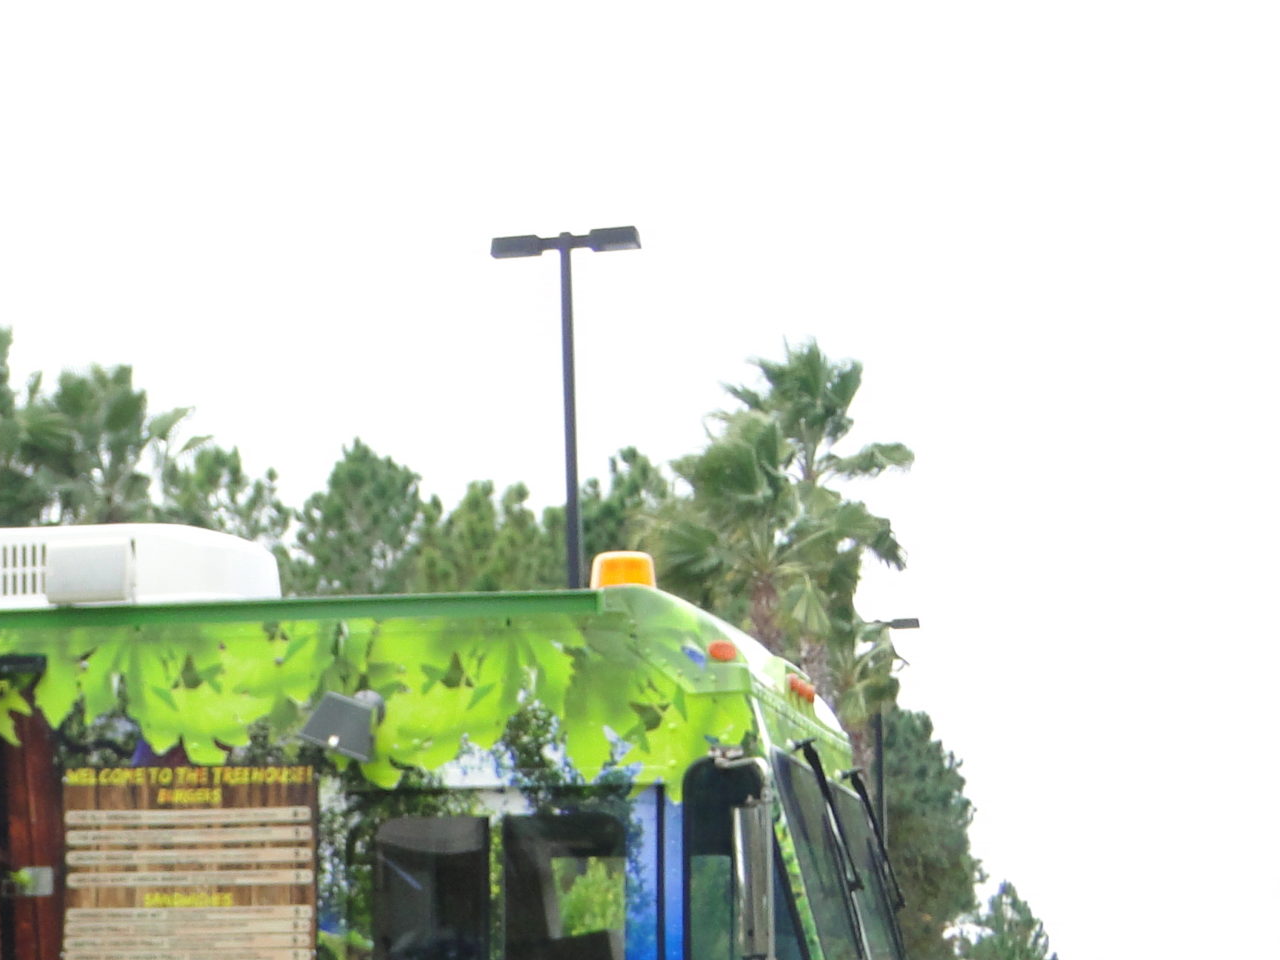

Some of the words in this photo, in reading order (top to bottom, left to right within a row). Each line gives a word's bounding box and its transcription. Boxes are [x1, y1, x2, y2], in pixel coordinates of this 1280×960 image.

[65, 767, 145, 786] WELCOME
[150, 767, 173, 786] TO
[175, 766, 208, 785] THE
